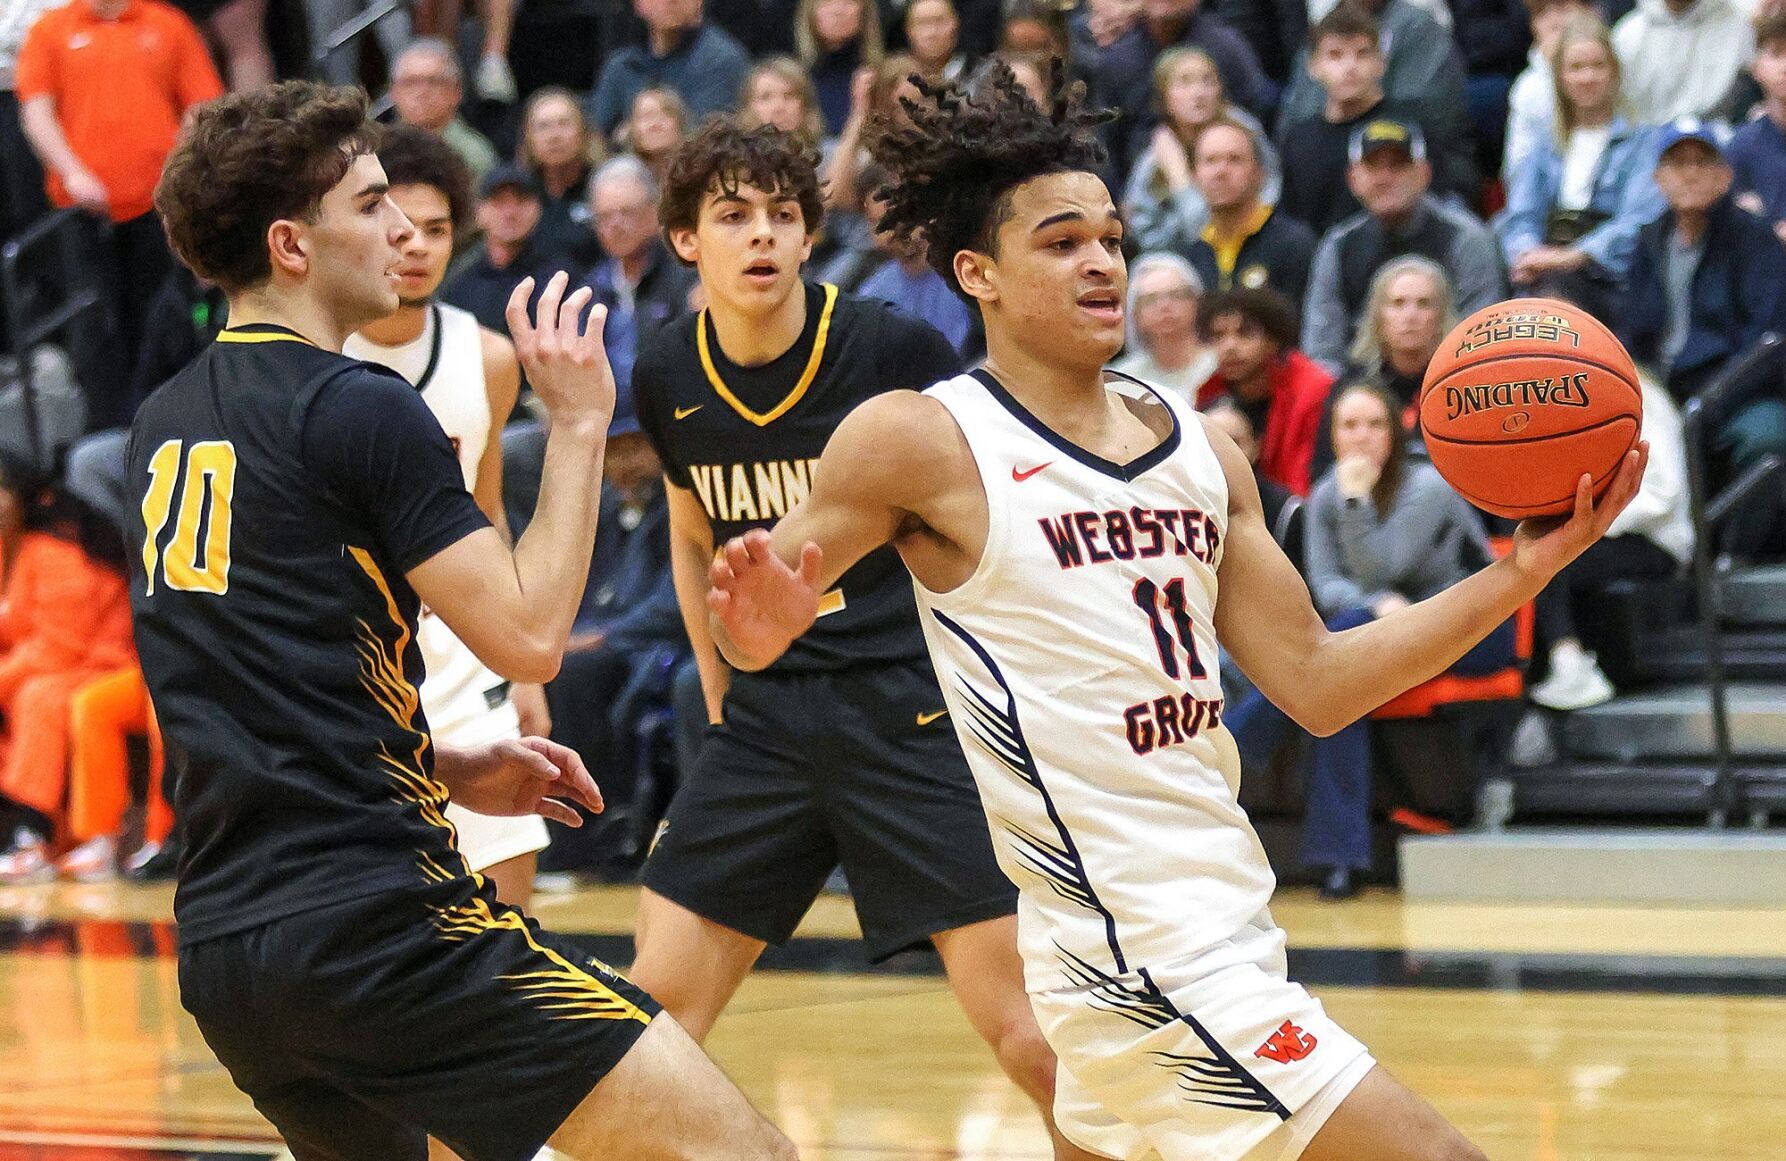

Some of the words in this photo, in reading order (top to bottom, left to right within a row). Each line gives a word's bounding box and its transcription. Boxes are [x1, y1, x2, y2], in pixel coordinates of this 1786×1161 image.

[1455, 322, 1581, 358] LEGACY
[1446, 373, 1590, 421] SPALDING
[141, 439, 237, 597] 10
[688, 459, 819, 521] VIANN
[1132, 576, 1207, 680] 11
